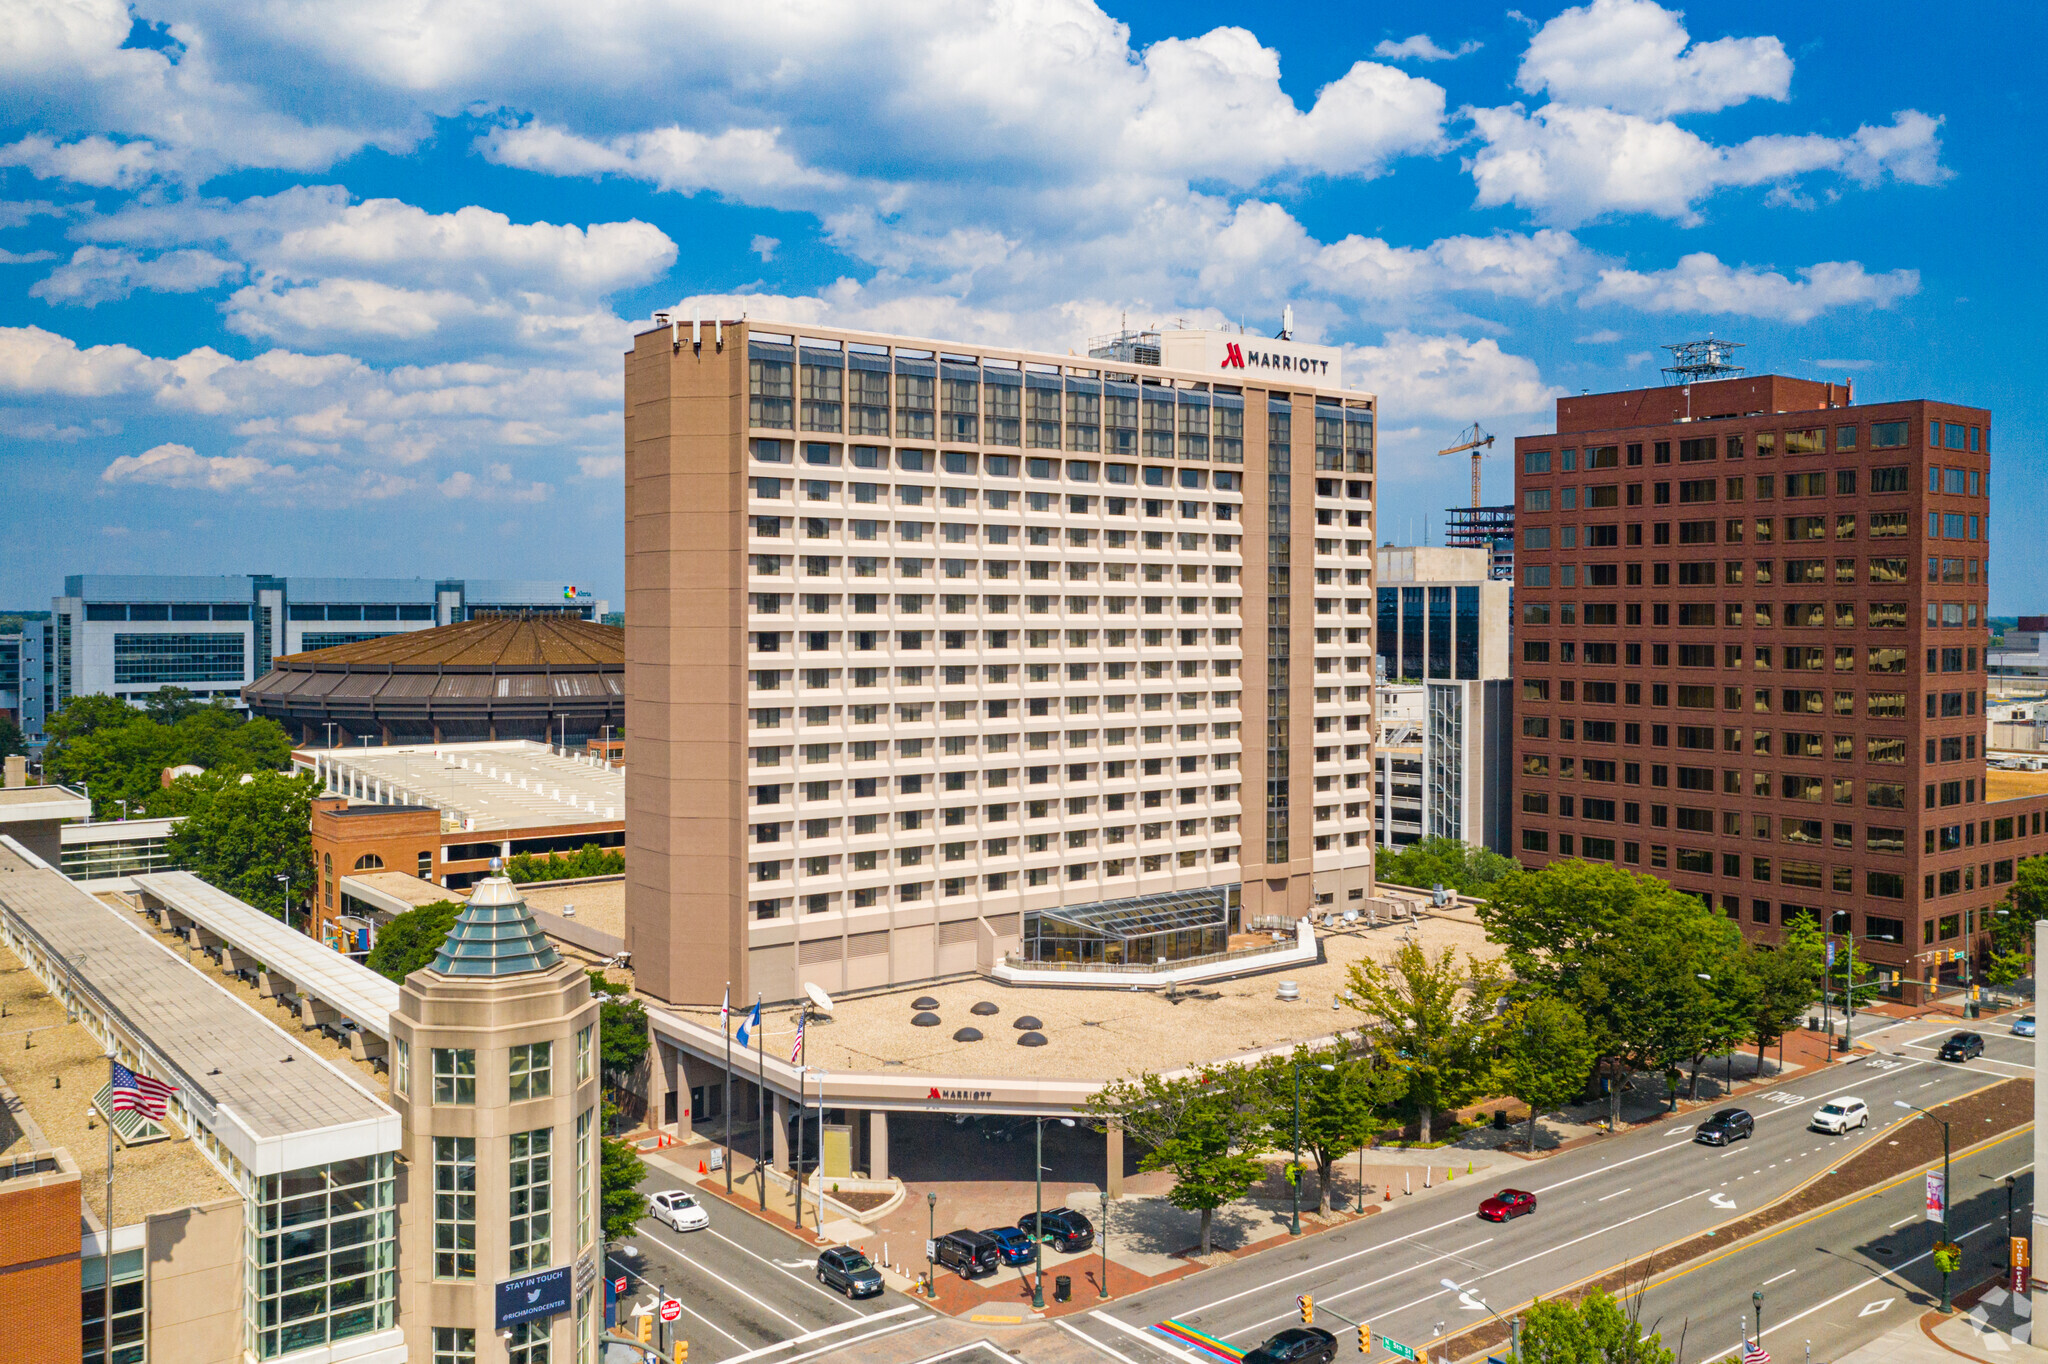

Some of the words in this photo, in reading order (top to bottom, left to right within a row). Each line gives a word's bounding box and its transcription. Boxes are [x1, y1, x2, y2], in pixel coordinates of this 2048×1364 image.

[1248, 350, 1329, 375] MARRIOTT
[1866, 1059, 1903, 1070] BUS
[942, 1090, 992, 1100] MARRIOTT
[1754, 1090, 1805, 1104] ONLY
[505, 1280, 525, 1292] STAY
[525, 1278, 535, 1287] IN
[536, 1271, 563, 1284] TOUCH
[502, 1299, 566, 1321] @RICHMONDCENTER
[1393, 1342, 1403, 1352] 5th
